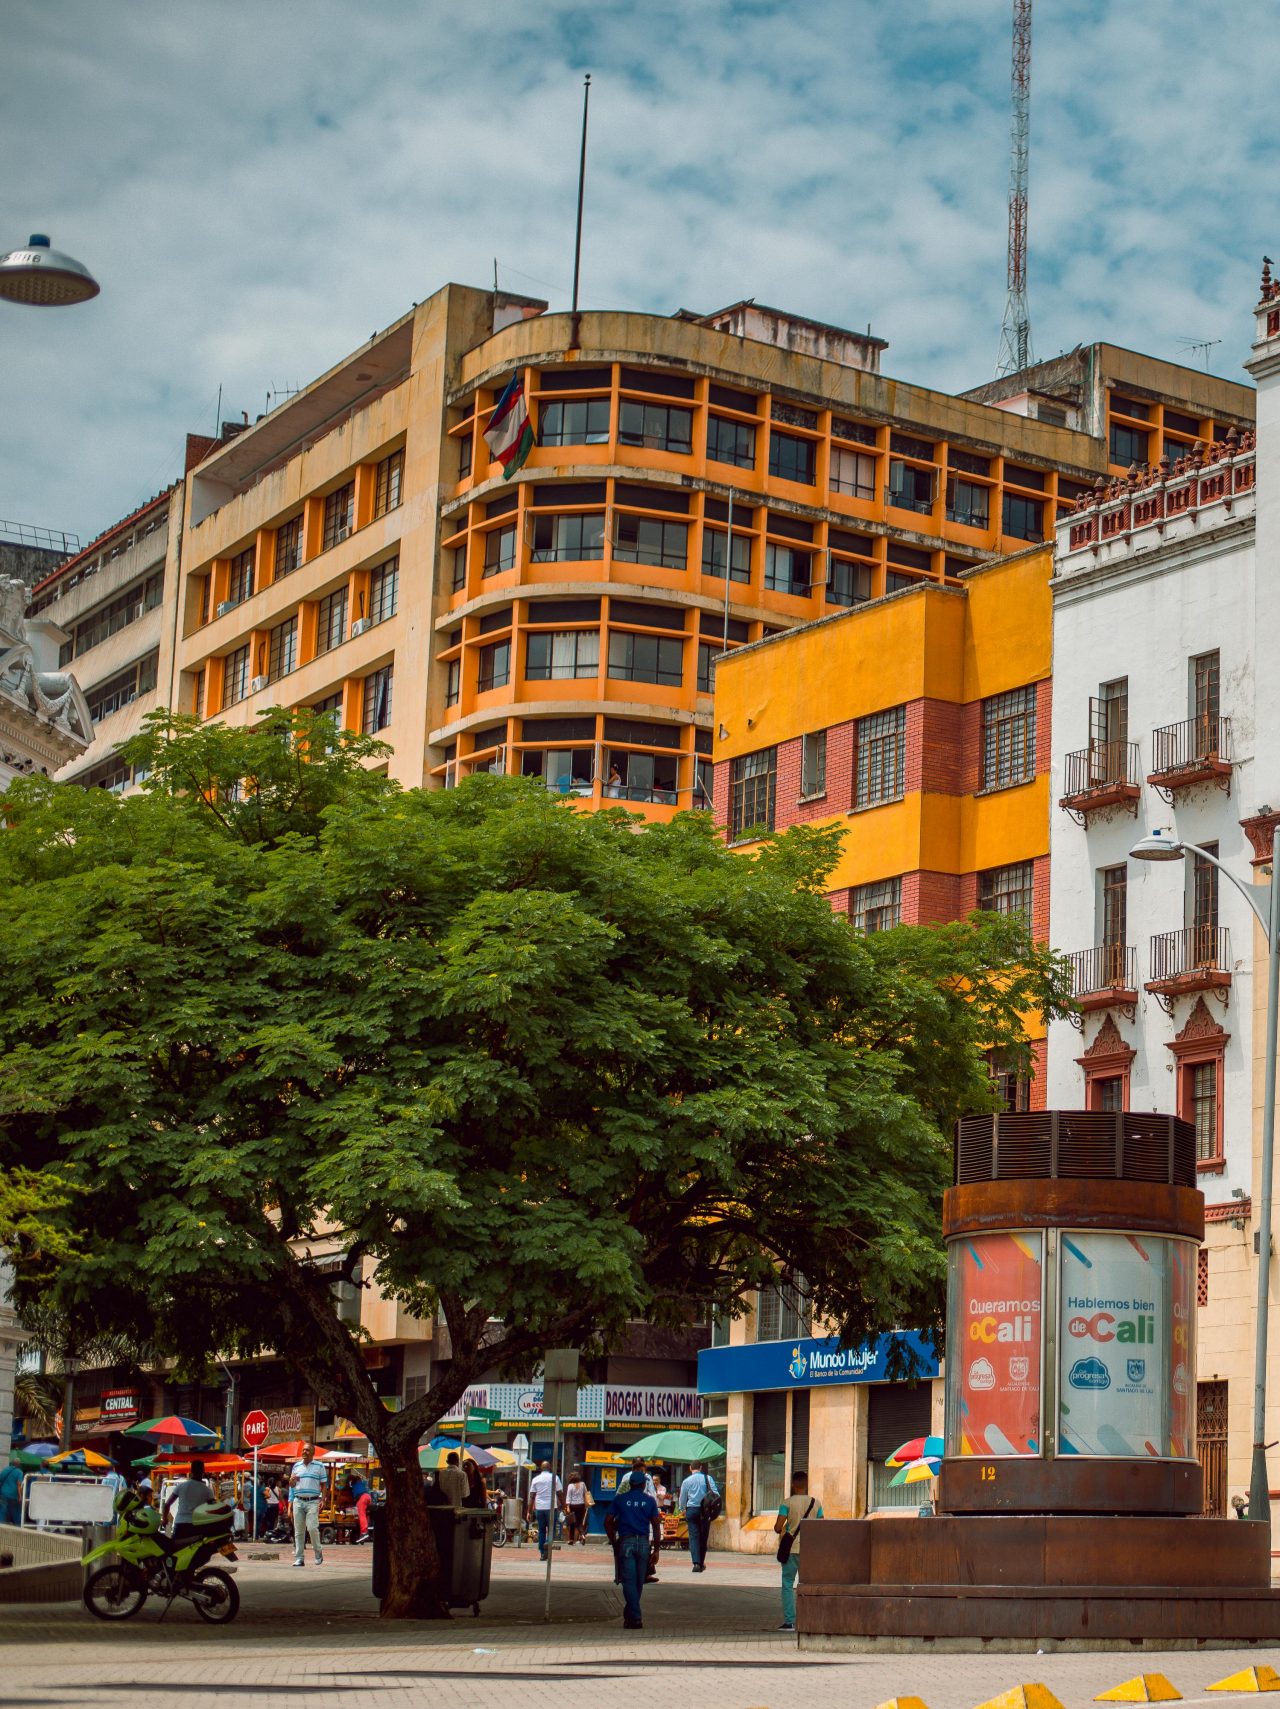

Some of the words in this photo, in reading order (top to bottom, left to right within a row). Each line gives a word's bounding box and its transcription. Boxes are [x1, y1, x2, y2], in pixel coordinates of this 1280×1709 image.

[970, 1299, 1040, 1314] Queramos
[1068, 1297, 1129, 1308] Hablemos
[1133, 1299, 1154, 1311] bien
[981, 1316, 1031, 1343] Cali
[1072, 1321, 1086, 1332] de
[1089, 1313, 1154, 1344] Cali
[106, 1397, 133, 1410] CENTRAL
[606, 1391, 642, 1416] DROGAS
[645, 1392, 654, 1416] LA
[247, 1423, 265, 1435] PARE
[982, 1466, 996, 1480] 12
